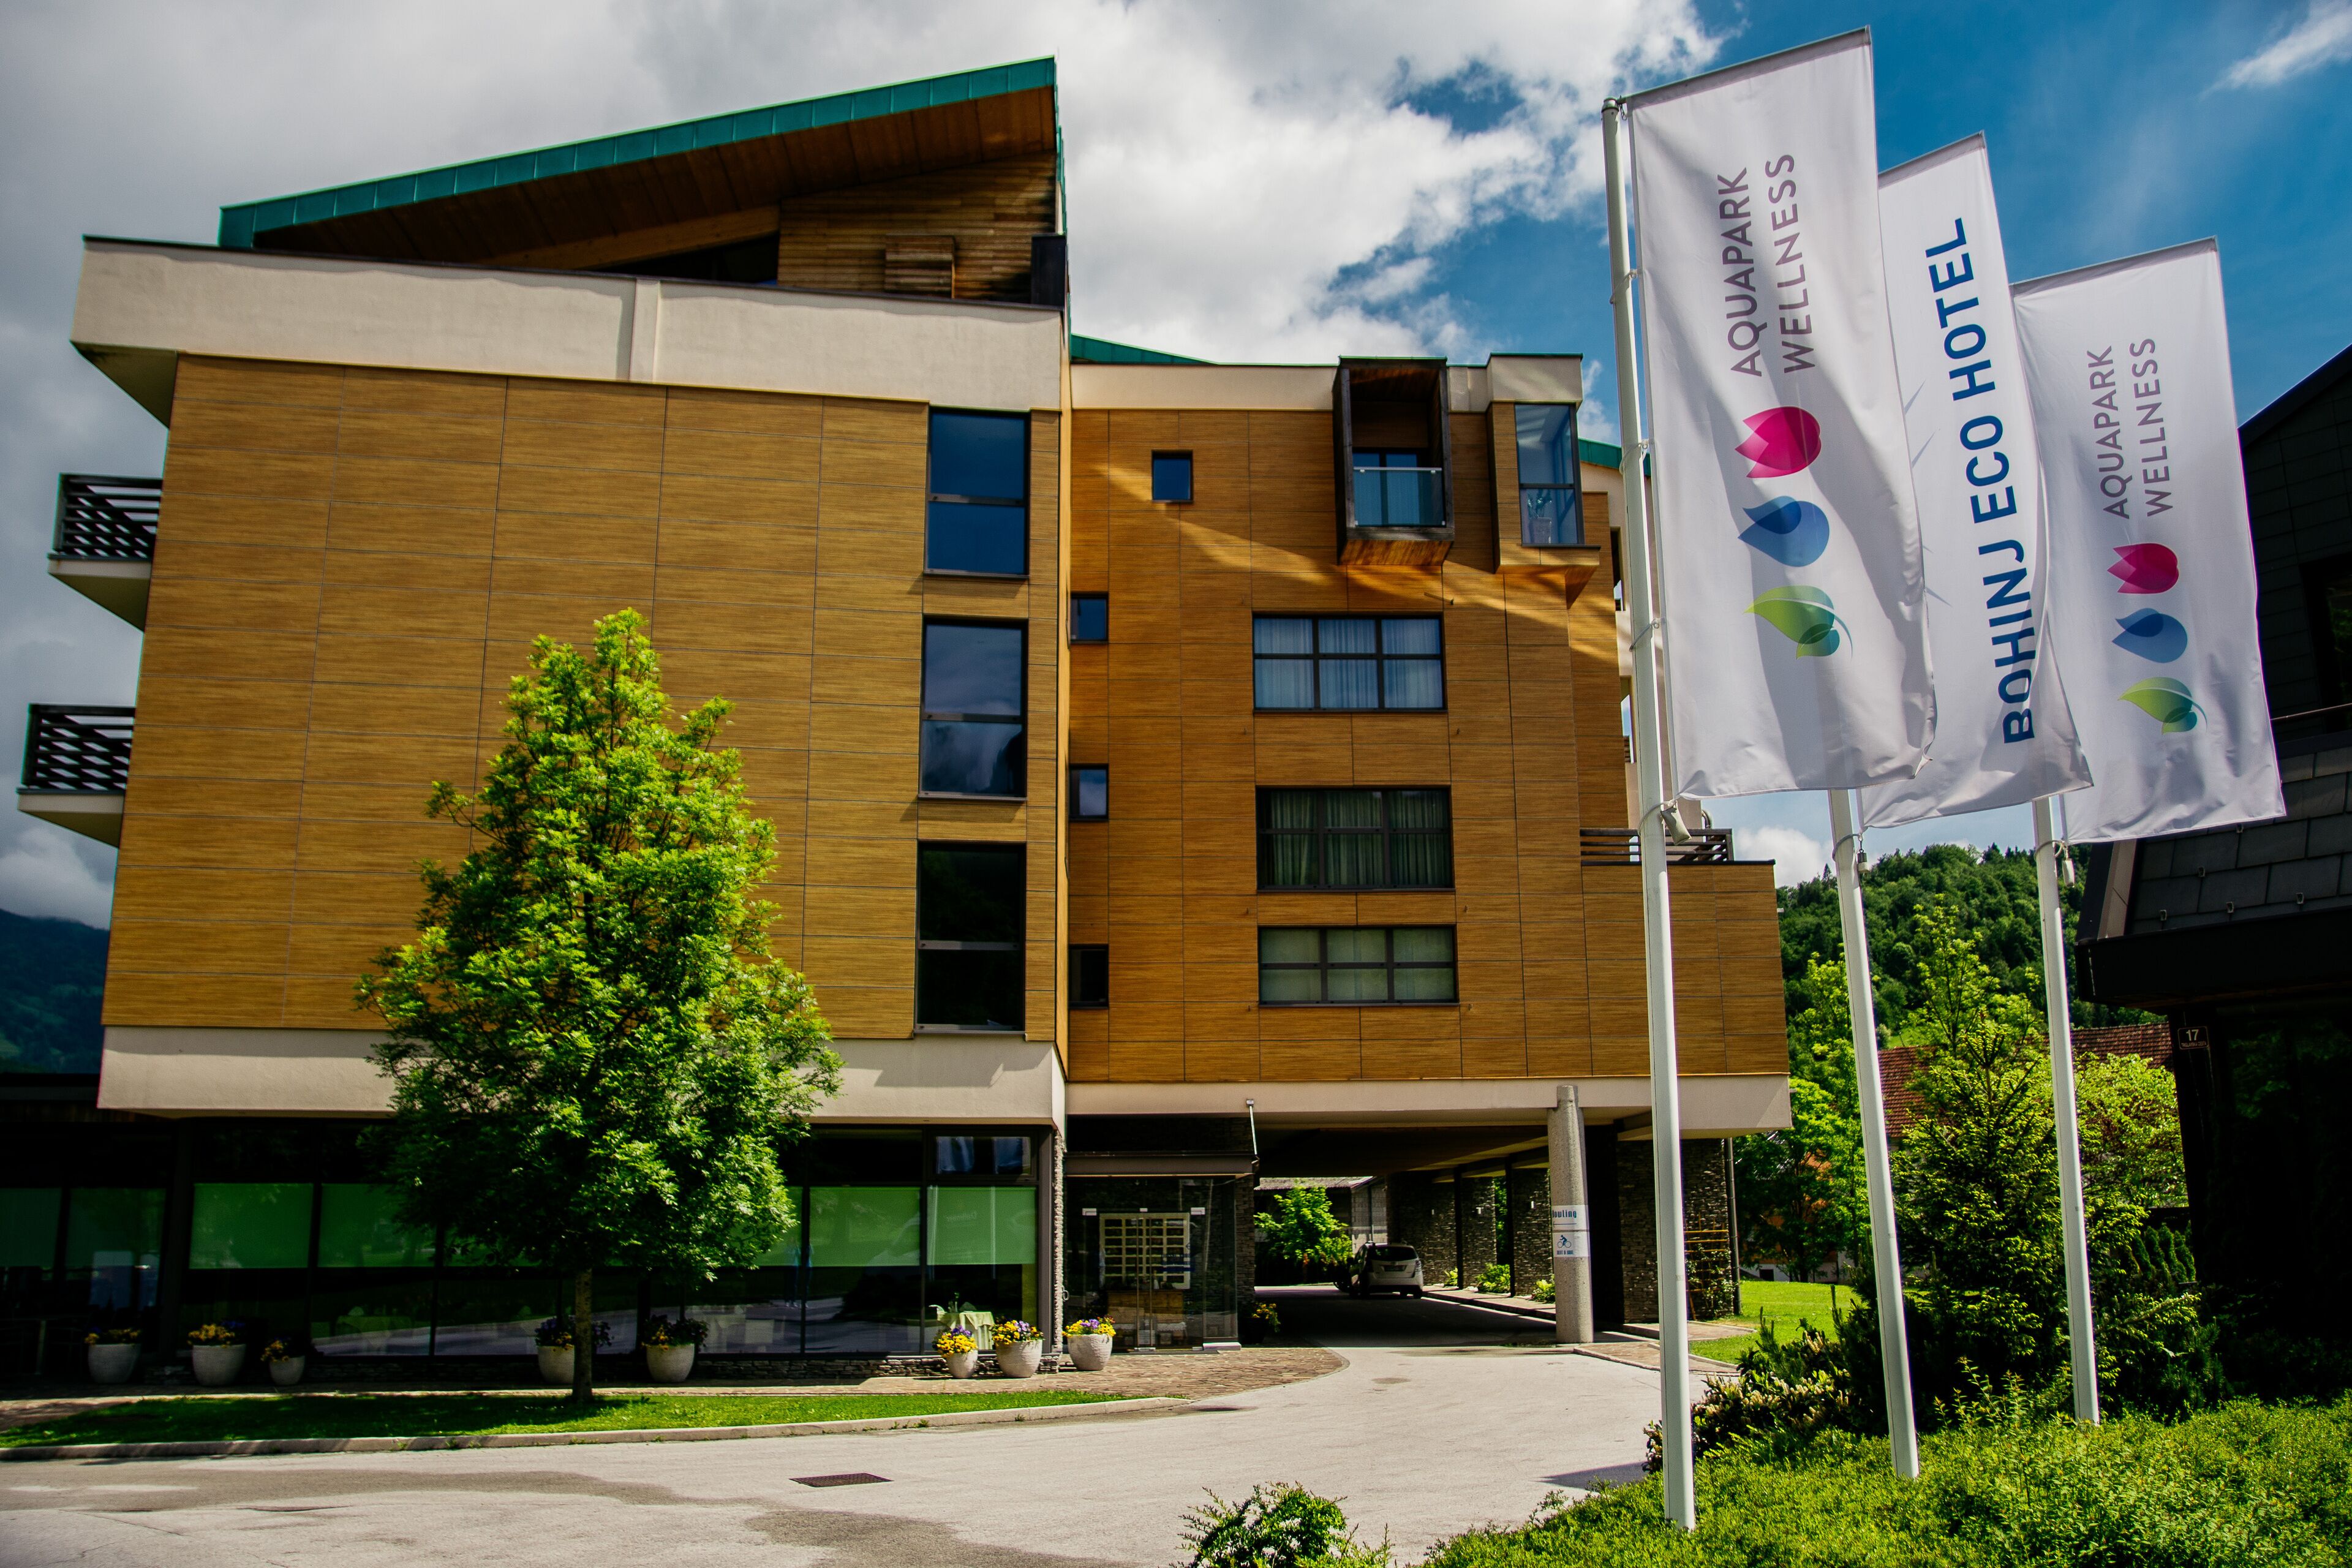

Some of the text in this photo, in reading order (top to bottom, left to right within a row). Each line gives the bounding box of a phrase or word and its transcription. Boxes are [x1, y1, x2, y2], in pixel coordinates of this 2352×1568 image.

[1717, 167, 1768, 377] AQUAPARK
[1765, 154, 1815, 374] WELLNESS
[1925, 217, 2037, 744] BOHINJ ECO HOTEL
[2086, 345, 2133, 520] AQUAPARK
[2128, 338, 2174, 518] WELLNESS
[2186, 1029, 2199, 1041] 17
